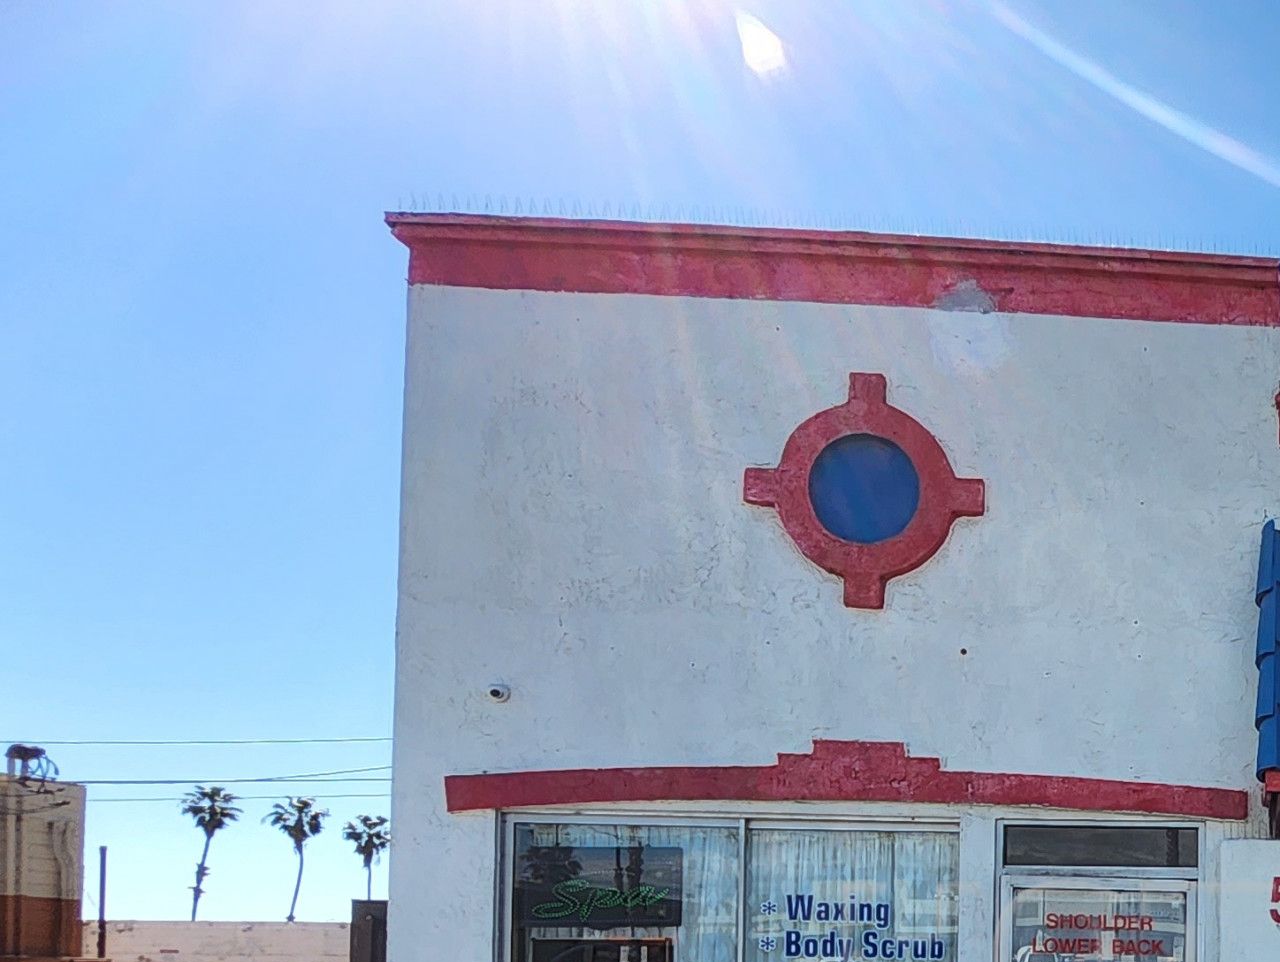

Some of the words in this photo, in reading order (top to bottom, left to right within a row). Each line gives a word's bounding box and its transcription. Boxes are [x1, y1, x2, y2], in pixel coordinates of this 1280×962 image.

[785, 893, 890, 929] Waxing
[1045, 913, 1154, 931] SHOULDER
[862, 931, 945, 959] Scrub
[1112, 938, 1165, 955] BACK
